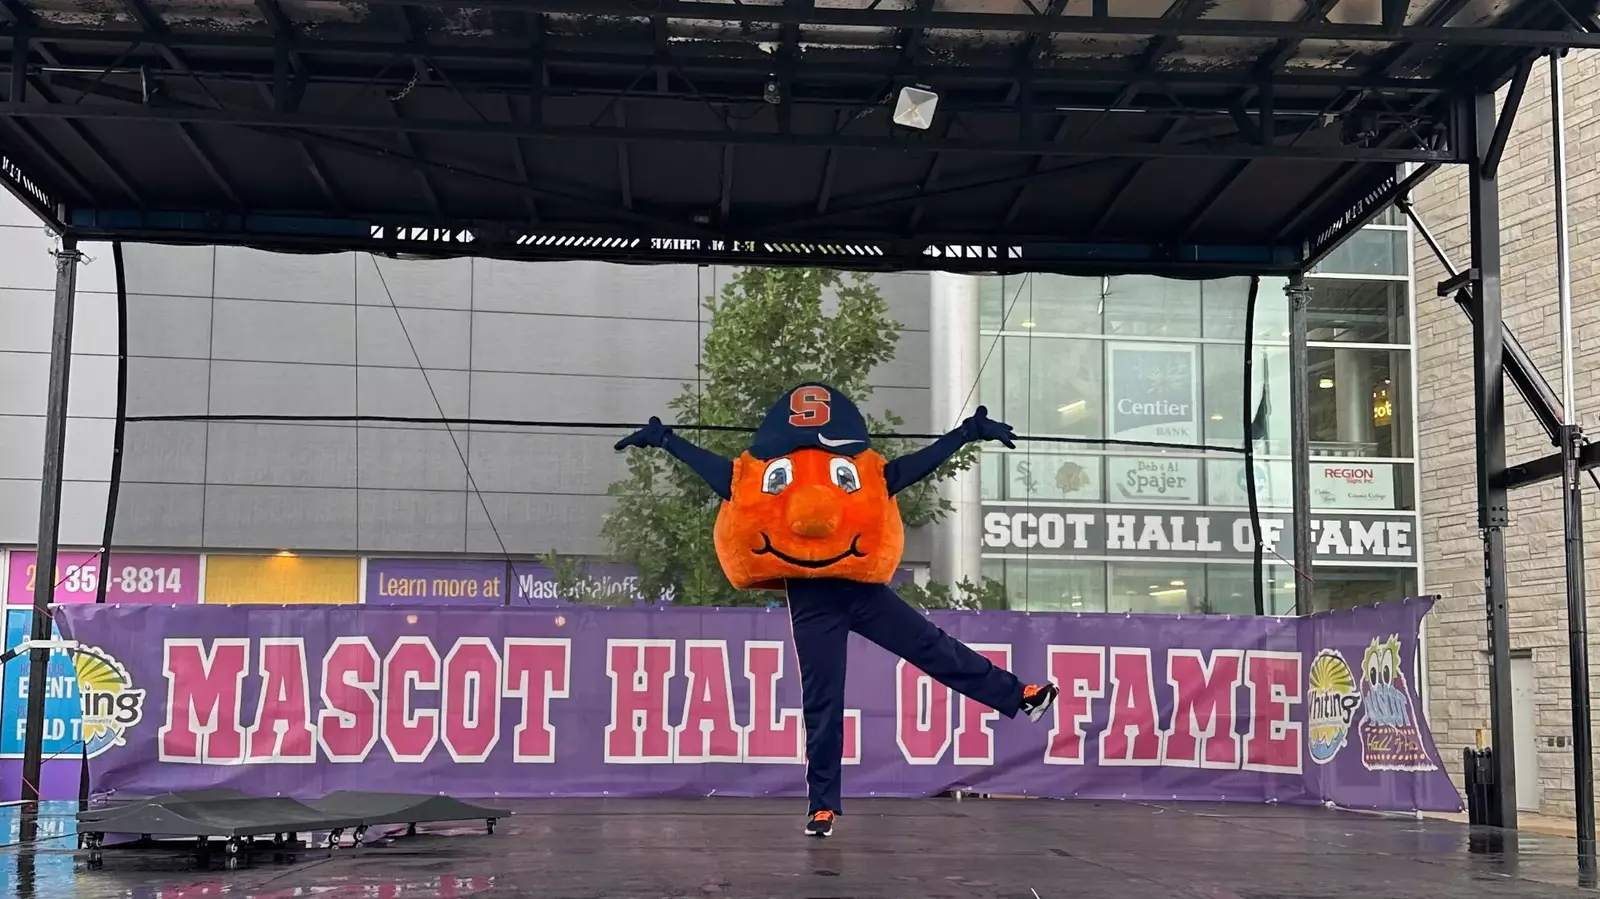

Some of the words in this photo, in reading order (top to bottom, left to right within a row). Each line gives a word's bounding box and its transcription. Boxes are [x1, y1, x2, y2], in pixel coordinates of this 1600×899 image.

[788, 385, 831, 427] S
[1117, 398, 1189, 416] Centier
[1155, 426, 1190, 437] BANK
[1137, 461, 1158, 472] Deb
[1324, 468, 1374, 479] REGION
[1126, 469, 1187, 493] Spajer
[981, 512, 1095, 549] SCOT
[1106, 515, 1222, 552] HALL
[379, 572, 427, 598] Learn
[432, 578, 477, 598] more
[483, 577, 501, 598] at
[18, 676, 76, 699] EENT
[158, 636, 572, 765] MASCOT
[1043, 645, 1303, 774] FAME
[16, 718, 66, 741] FLD
